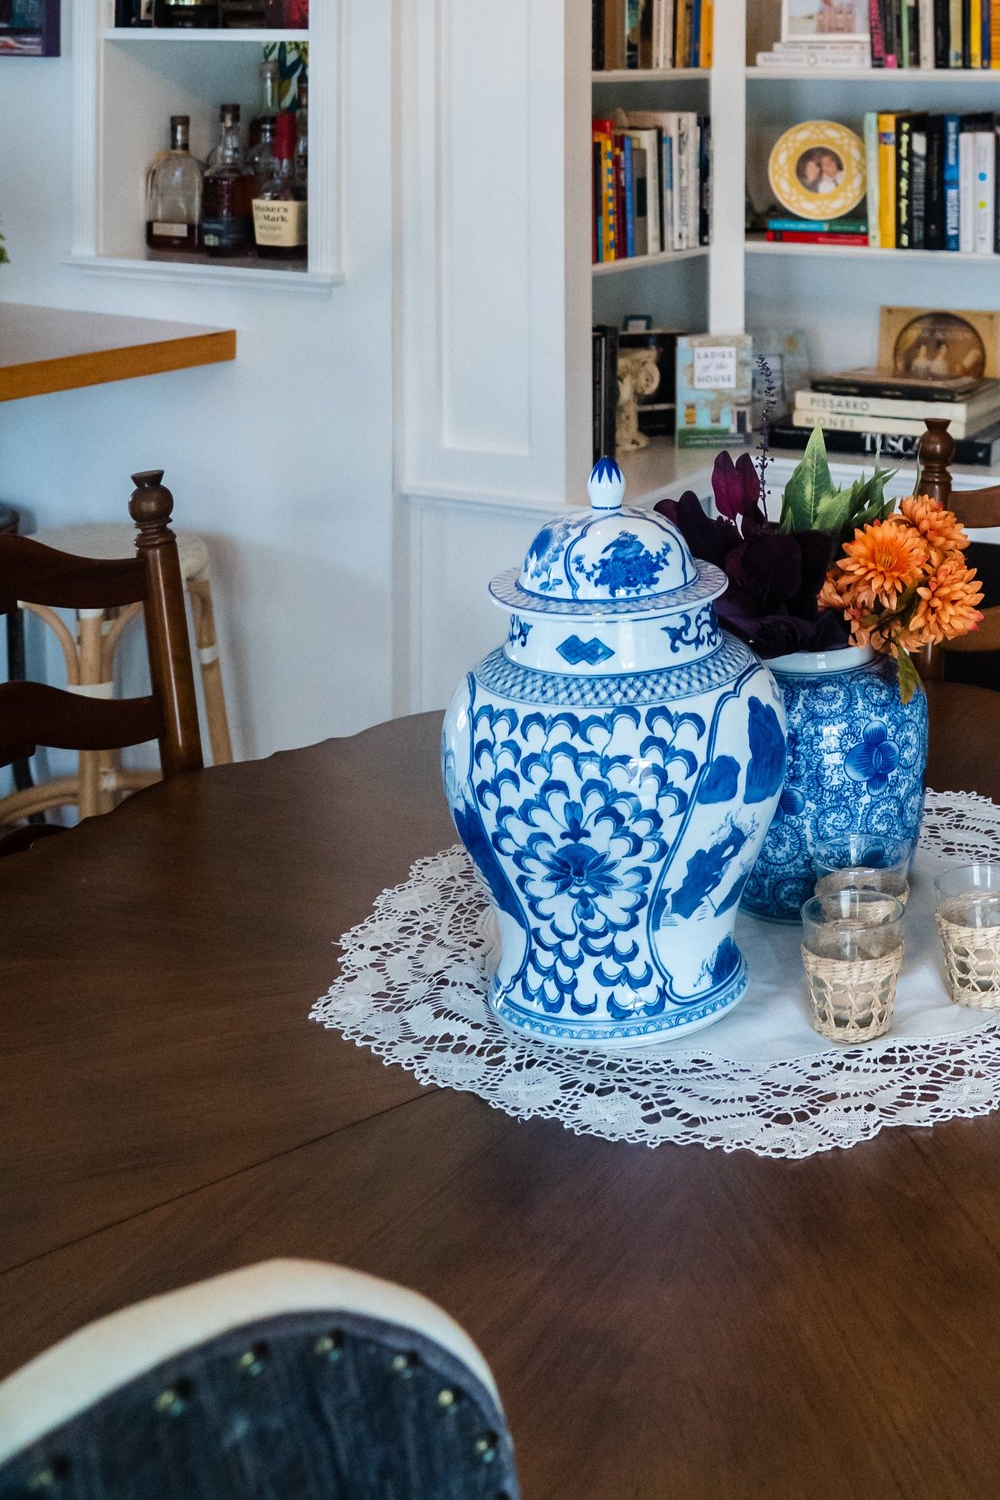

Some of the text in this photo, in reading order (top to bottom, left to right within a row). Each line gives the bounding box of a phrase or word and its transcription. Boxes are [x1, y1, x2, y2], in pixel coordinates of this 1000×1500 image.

[253, 203, 289, 213] Maker's
[696, 350, 733, 359] LADIES
[696, 374, 732, 383] HOUSE
[809, 396, 870, 412] PISSARRO
[804, 416, 855, 429] MONET
